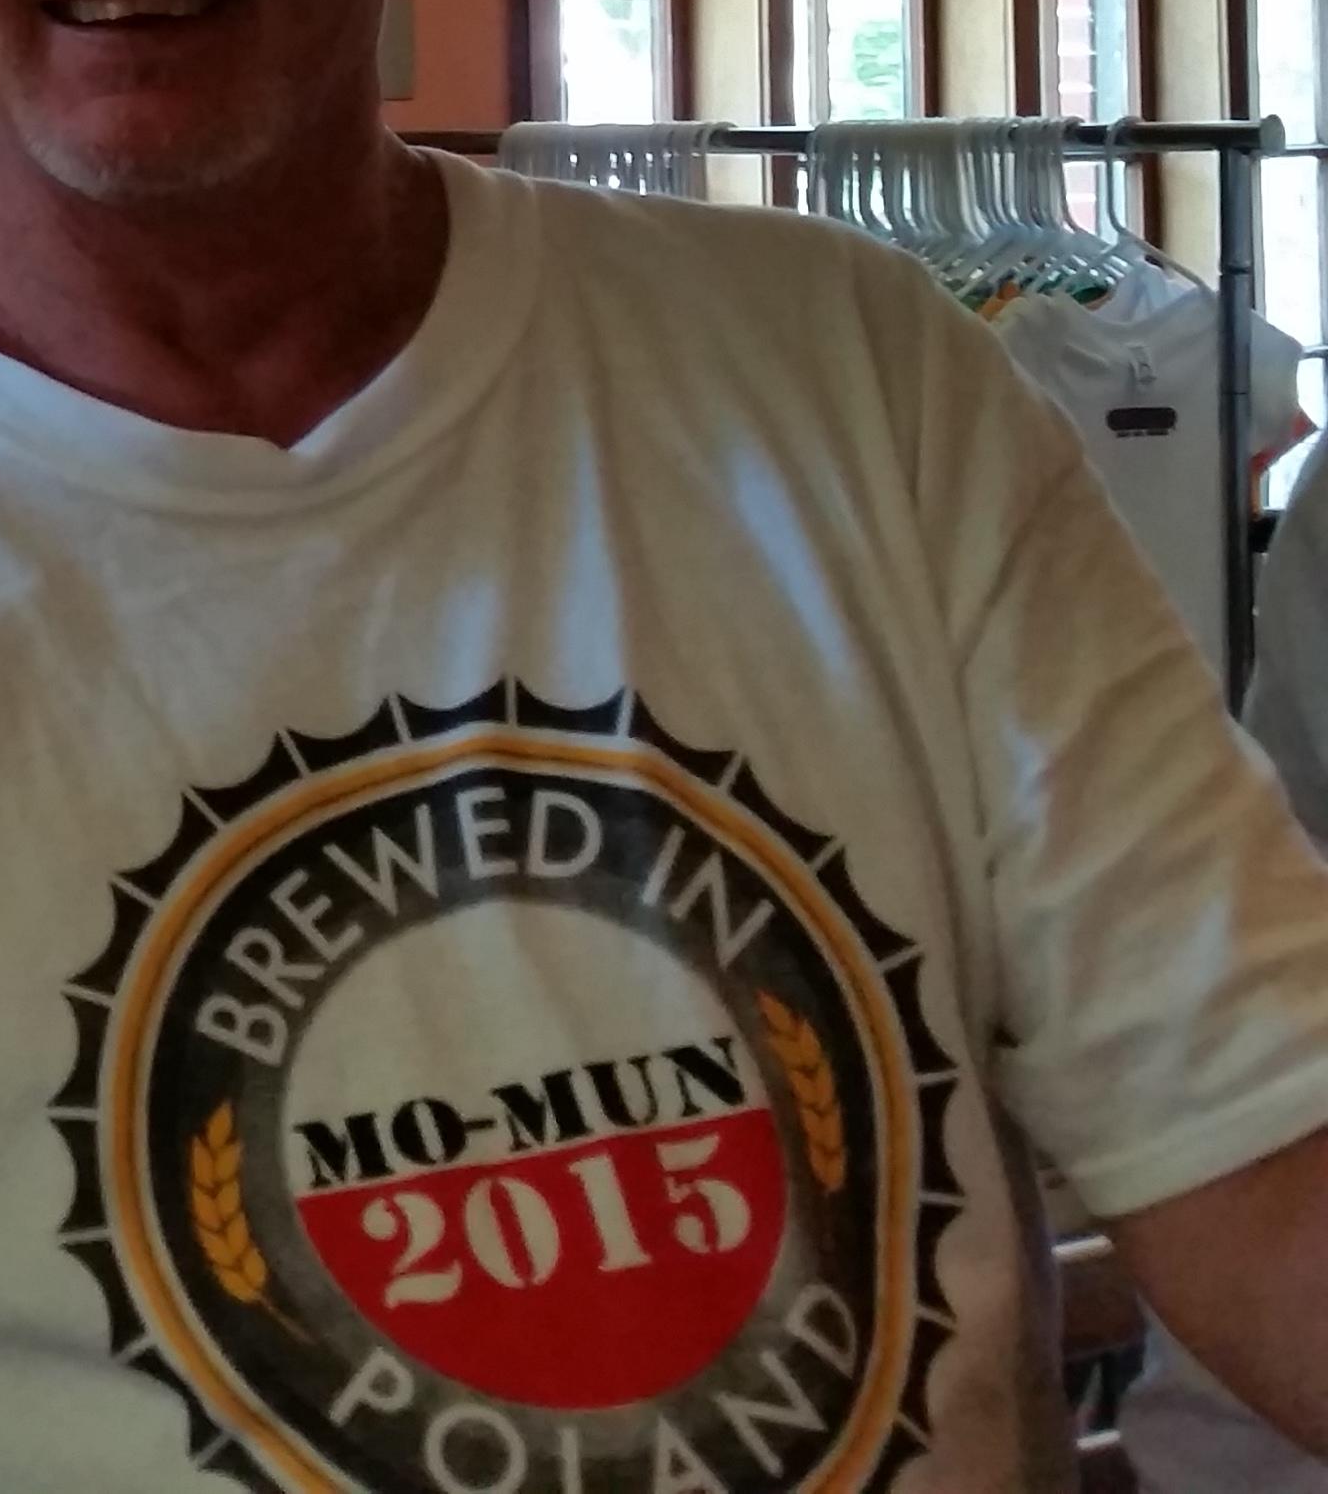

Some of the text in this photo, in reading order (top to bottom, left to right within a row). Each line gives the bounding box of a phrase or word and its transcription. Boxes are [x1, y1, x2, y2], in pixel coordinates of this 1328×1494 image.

[196, 786, 777, 1064] BREWED IN
[294, 1037, 748, 1188] MO-MUN
[361, 1132, 752, 1308] 2015
